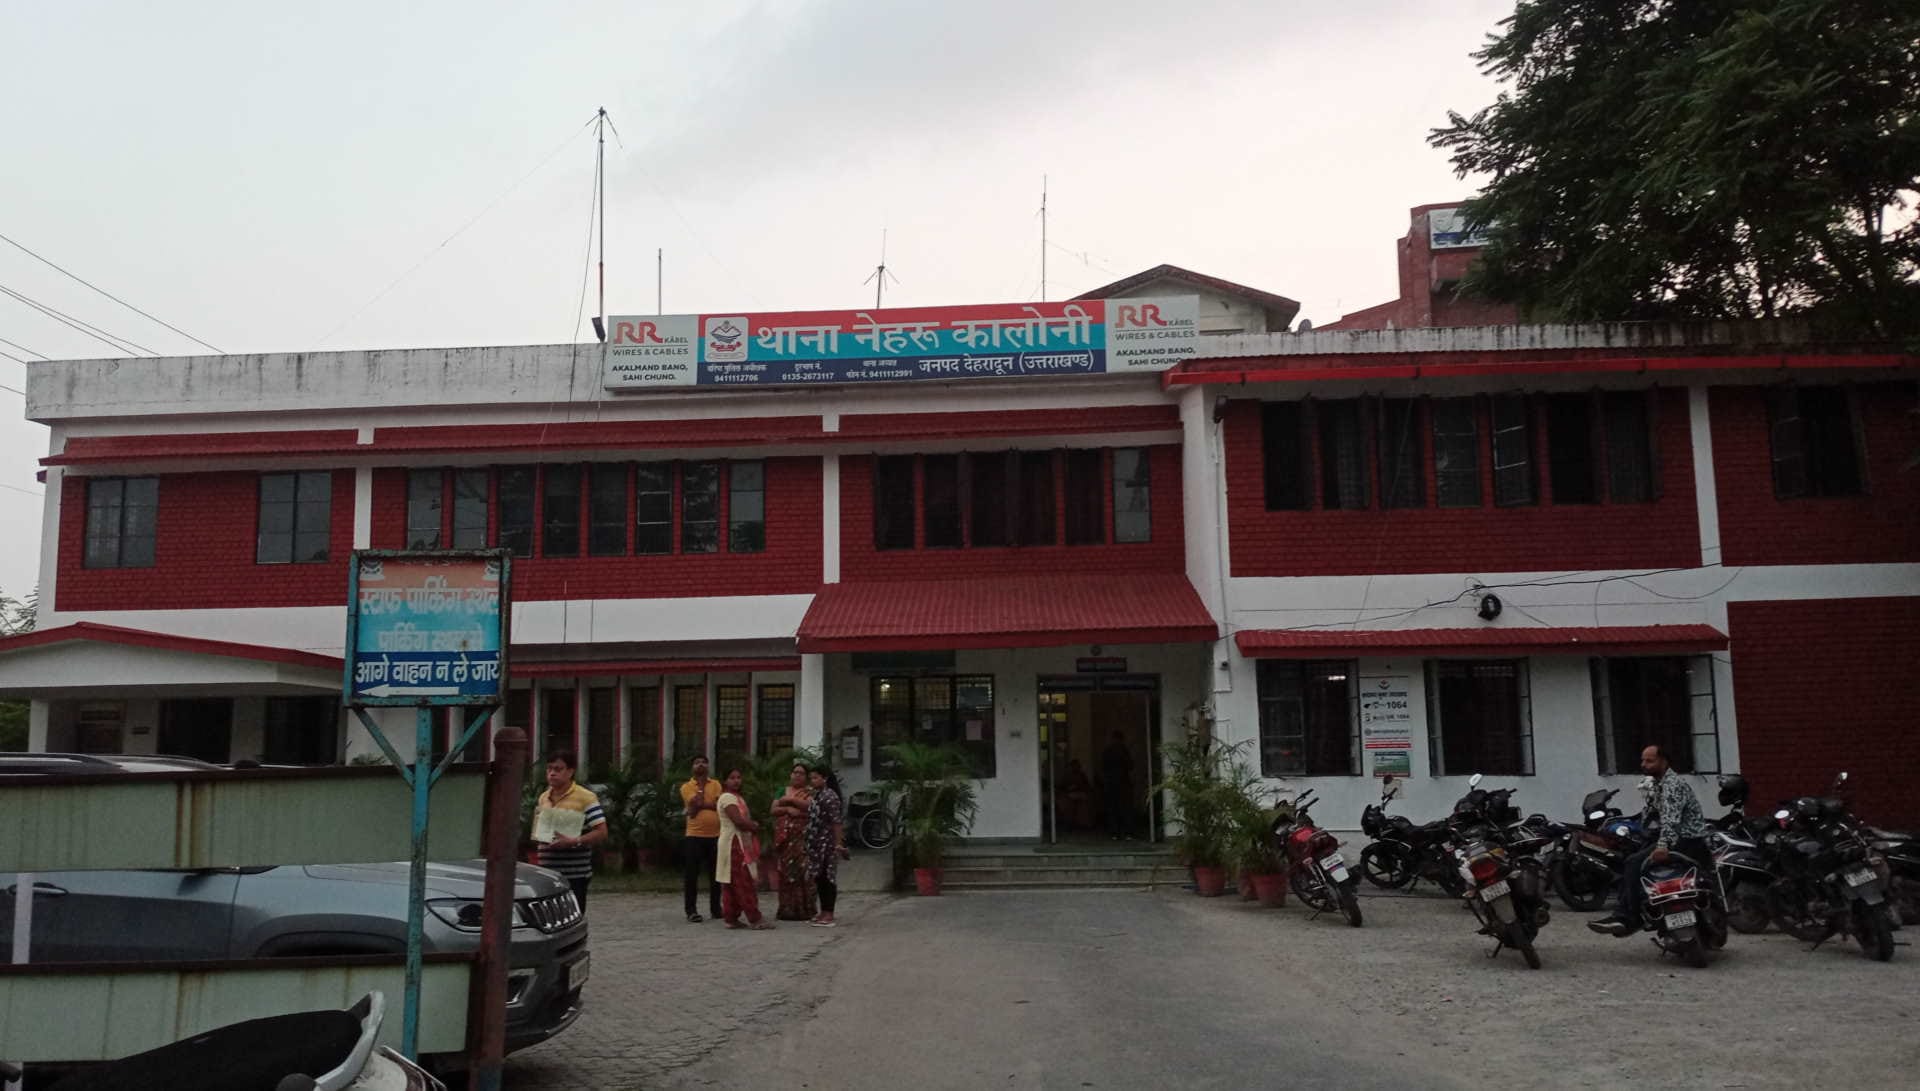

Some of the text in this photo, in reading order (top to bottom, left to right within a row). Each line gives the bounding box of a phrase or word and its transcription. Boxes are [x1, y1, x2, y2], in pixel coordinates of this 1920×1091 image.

[1115, 304, 1167, 328] RR
[613, 321, 663, 344] RR
[756, 304, 1093, 355] थाना नेहरू कालोनी
[1116, 332, 1146, 340] WIRES
[1157, 331, 1195, 339] CABLES
[612, 348, 642, 356] WIRES
[652, 347, 688, 355] CABLES
[1116, 348, 1166, 356] AKALMAND
[612, 364, 688, 372] AKALMAND BANO,
[919, 349, 1095, 375] जनपद देहरादून (उत्तराखण्ड)
[1128, 358, 1149, 366] SAHI
[355, 653, 390, 683] आगे
[392, 661, 433, 684] वाहन
[436, 661, 450, 682] न
[453, 652, 469, 683] ले
